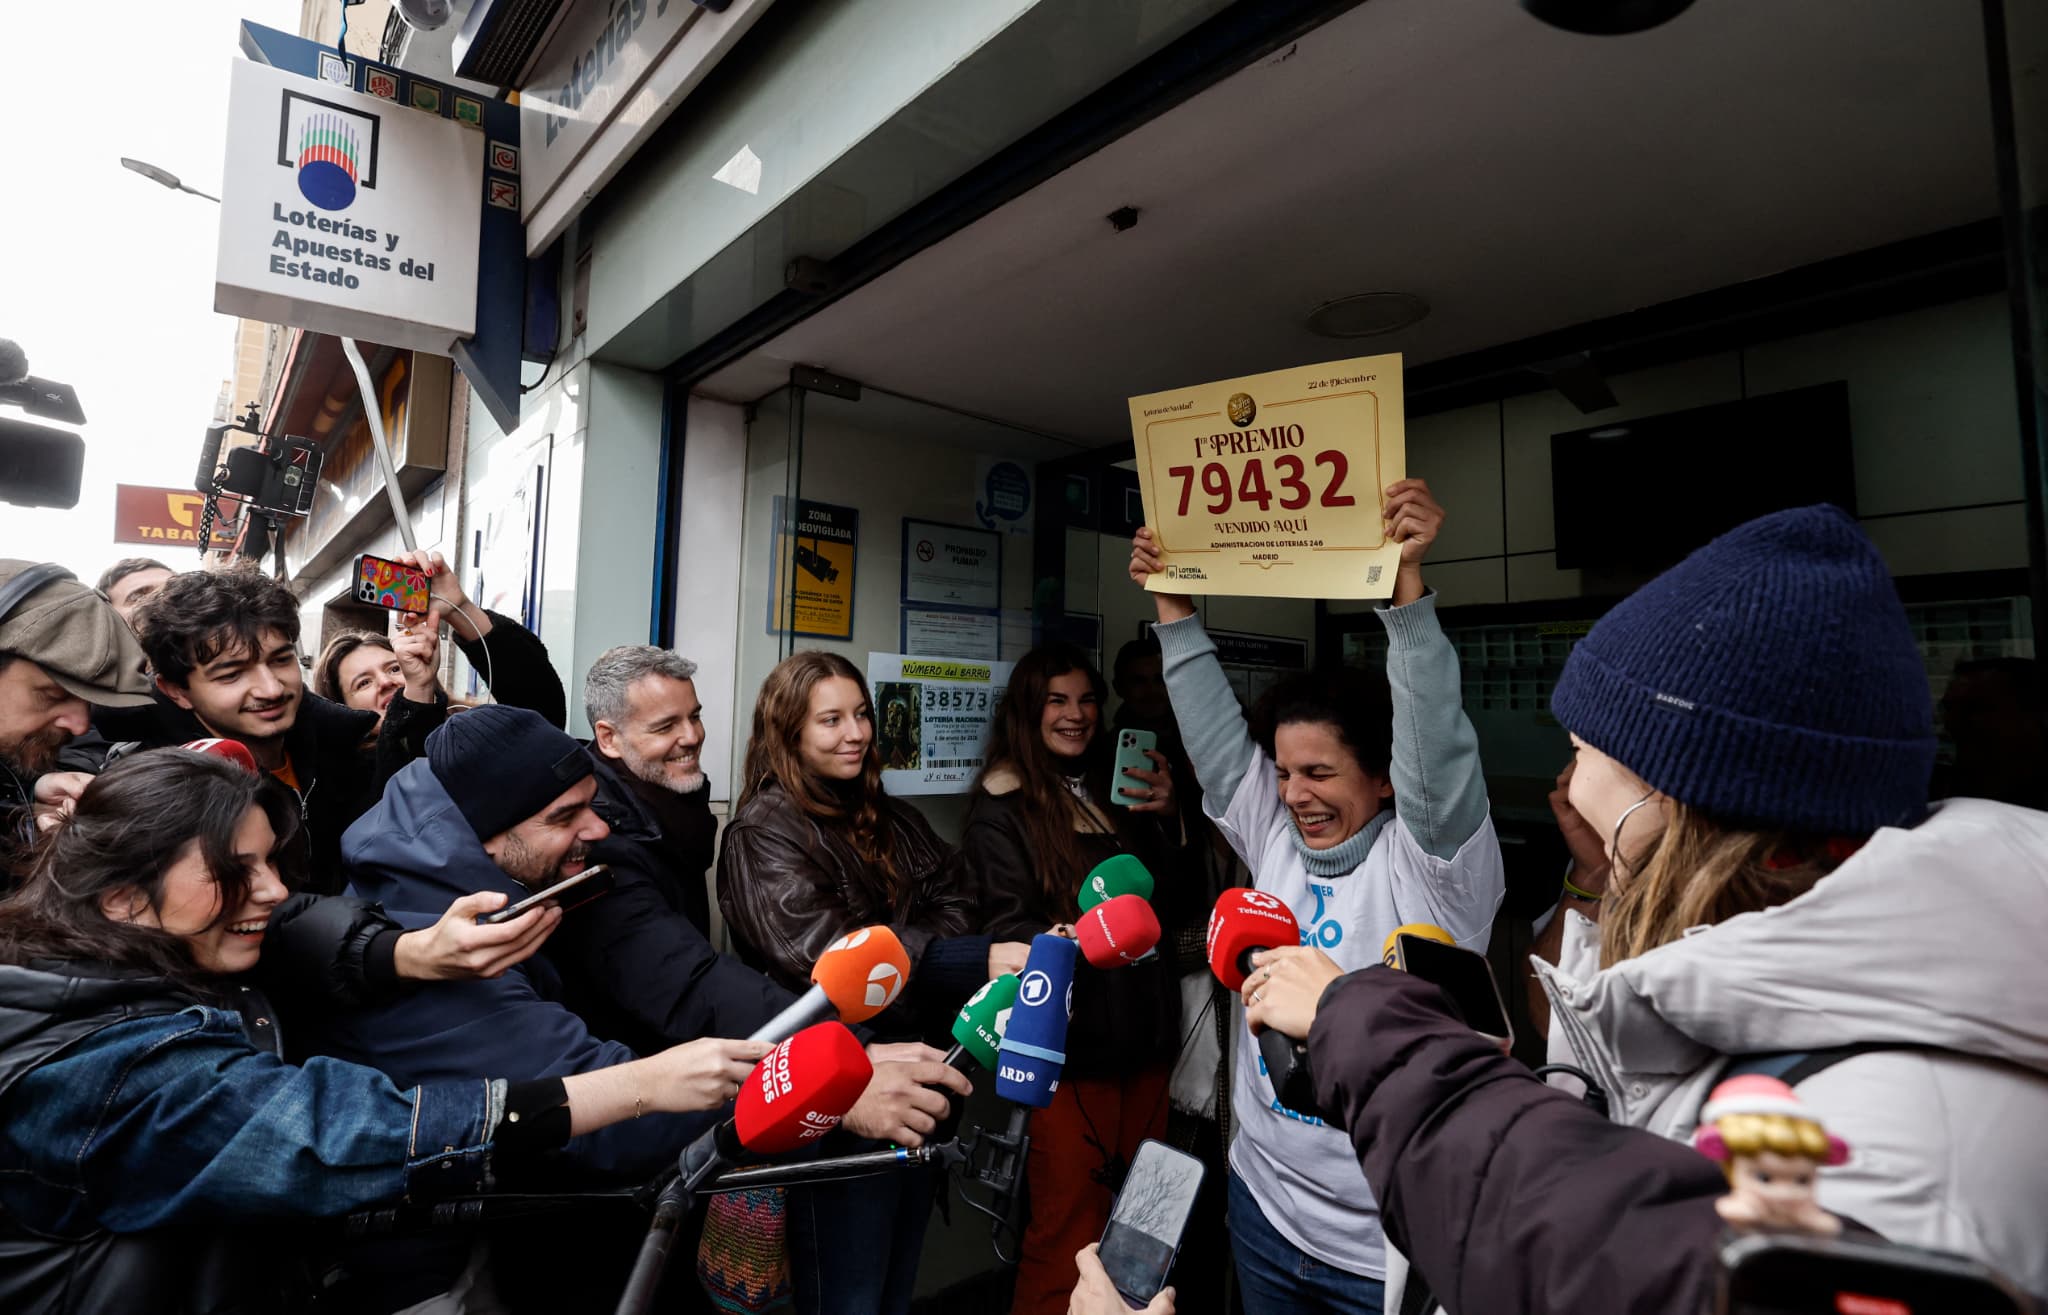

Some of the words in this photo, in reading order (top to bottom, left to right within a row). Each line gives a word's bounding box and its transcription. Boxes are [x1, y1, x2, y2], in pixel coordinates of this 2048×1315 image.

[273, 202, 377, 242] Loterías
[385, 233, 399, 252] y
[272, 230, 391, 271] Apuestas
[399, 258, 435, 281] del
[270, 254, 360, 289] Estado
[1307, 380, 1318, 389] 22
[1318, 379, 1328, 388] de
[1329, 374, 1377, 387] Diciembre
[1209, 424, 1305, 456] PREMIO
[1169, 449, 1355, 516] 79432
[808, 510, 832, 523] ZONA
[1214, 520, 1270, 534] VENDIDO
[1273, 515, 1308, 535] AQUÍ
[945, 544, 987, 558] PROHIBIDO
[952, 556, 979, 567] FUMAR
[903, 662, 942, 676] NÚMERO
[944, 666, 958, 676] del
[960, 668, 992, 679] BARRIO
[926, 690, 987, 708] 38573
[1237, 907, 1292, 925] TeleMadrid
[776, 1036, 794, 1095] europa
[762, 1053, 775, 1104] press
